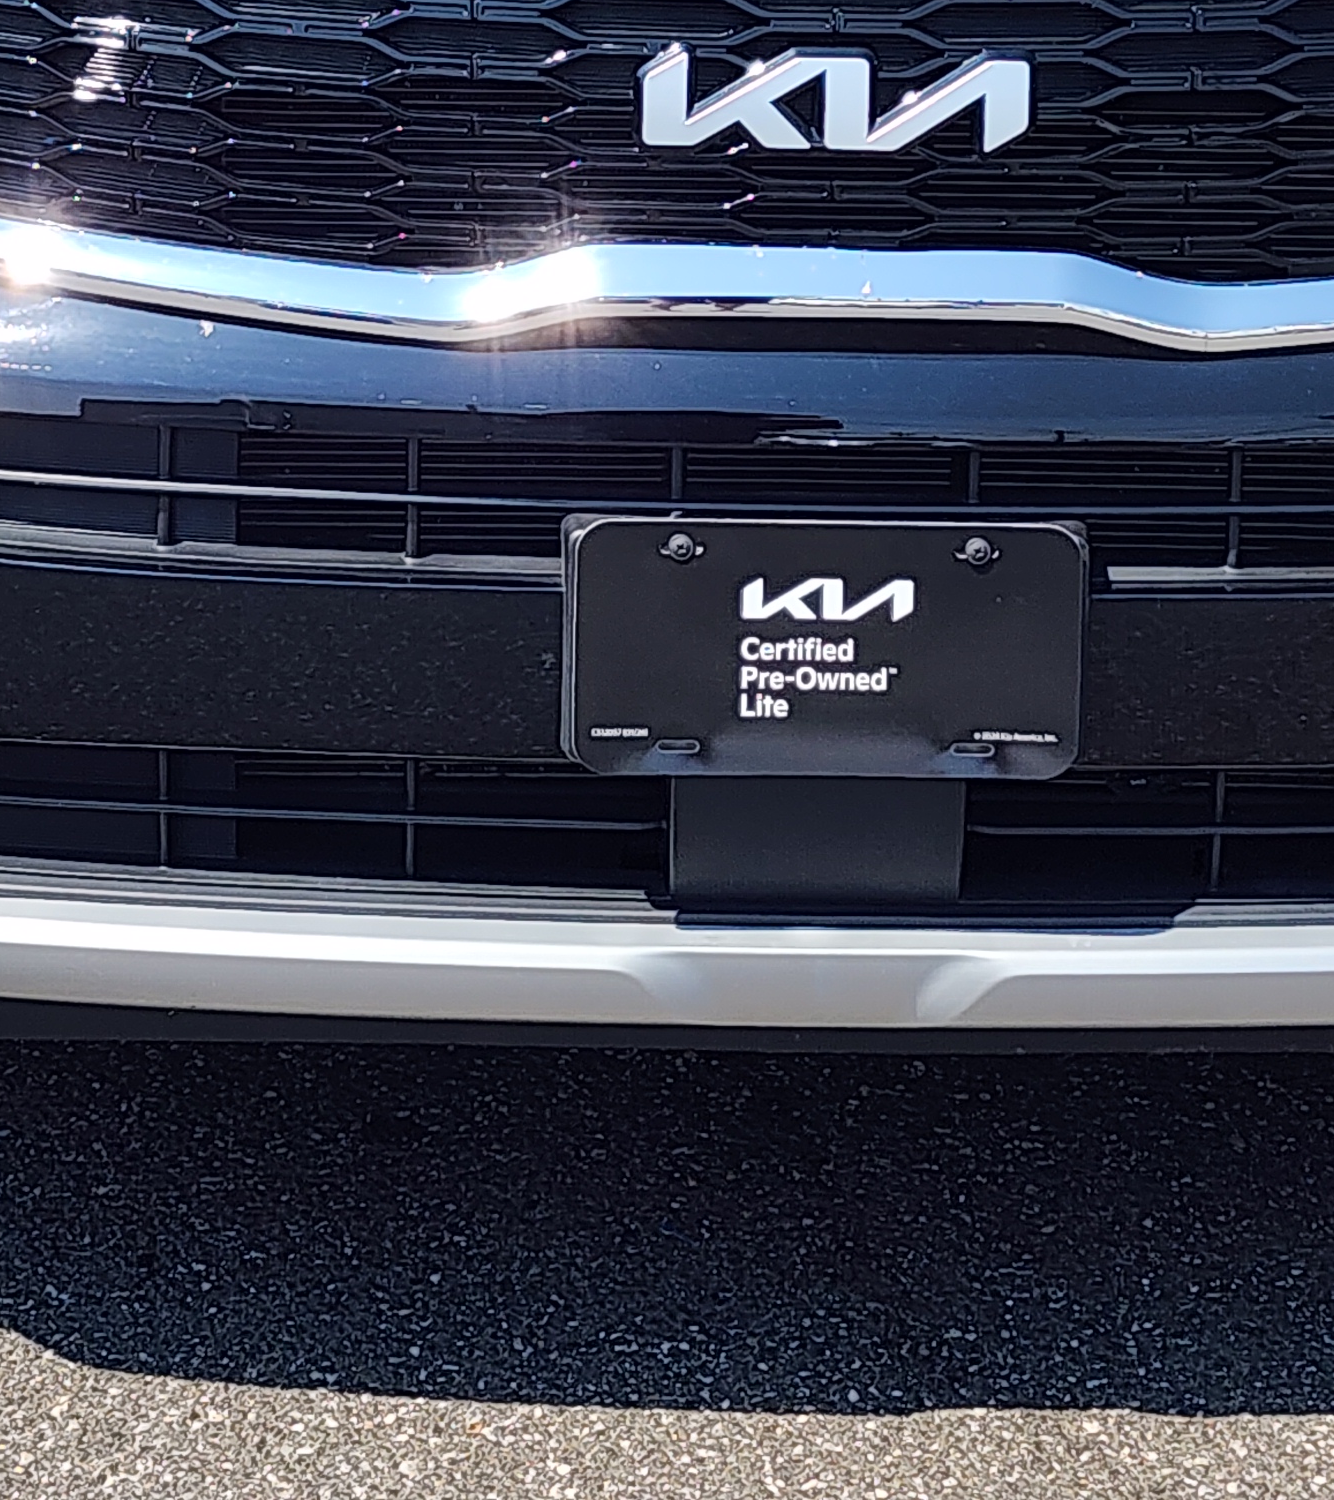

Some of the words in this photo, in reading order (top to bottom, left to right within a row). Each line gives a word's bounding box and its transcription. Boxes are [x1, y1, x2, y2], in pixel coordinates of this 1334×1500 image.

[641, 46, 1031, 154] KIA
[741, 577, 915, 622] KIA
[740, 636, 855, 662] Certified
[740, 693, 790, 718] Lite
